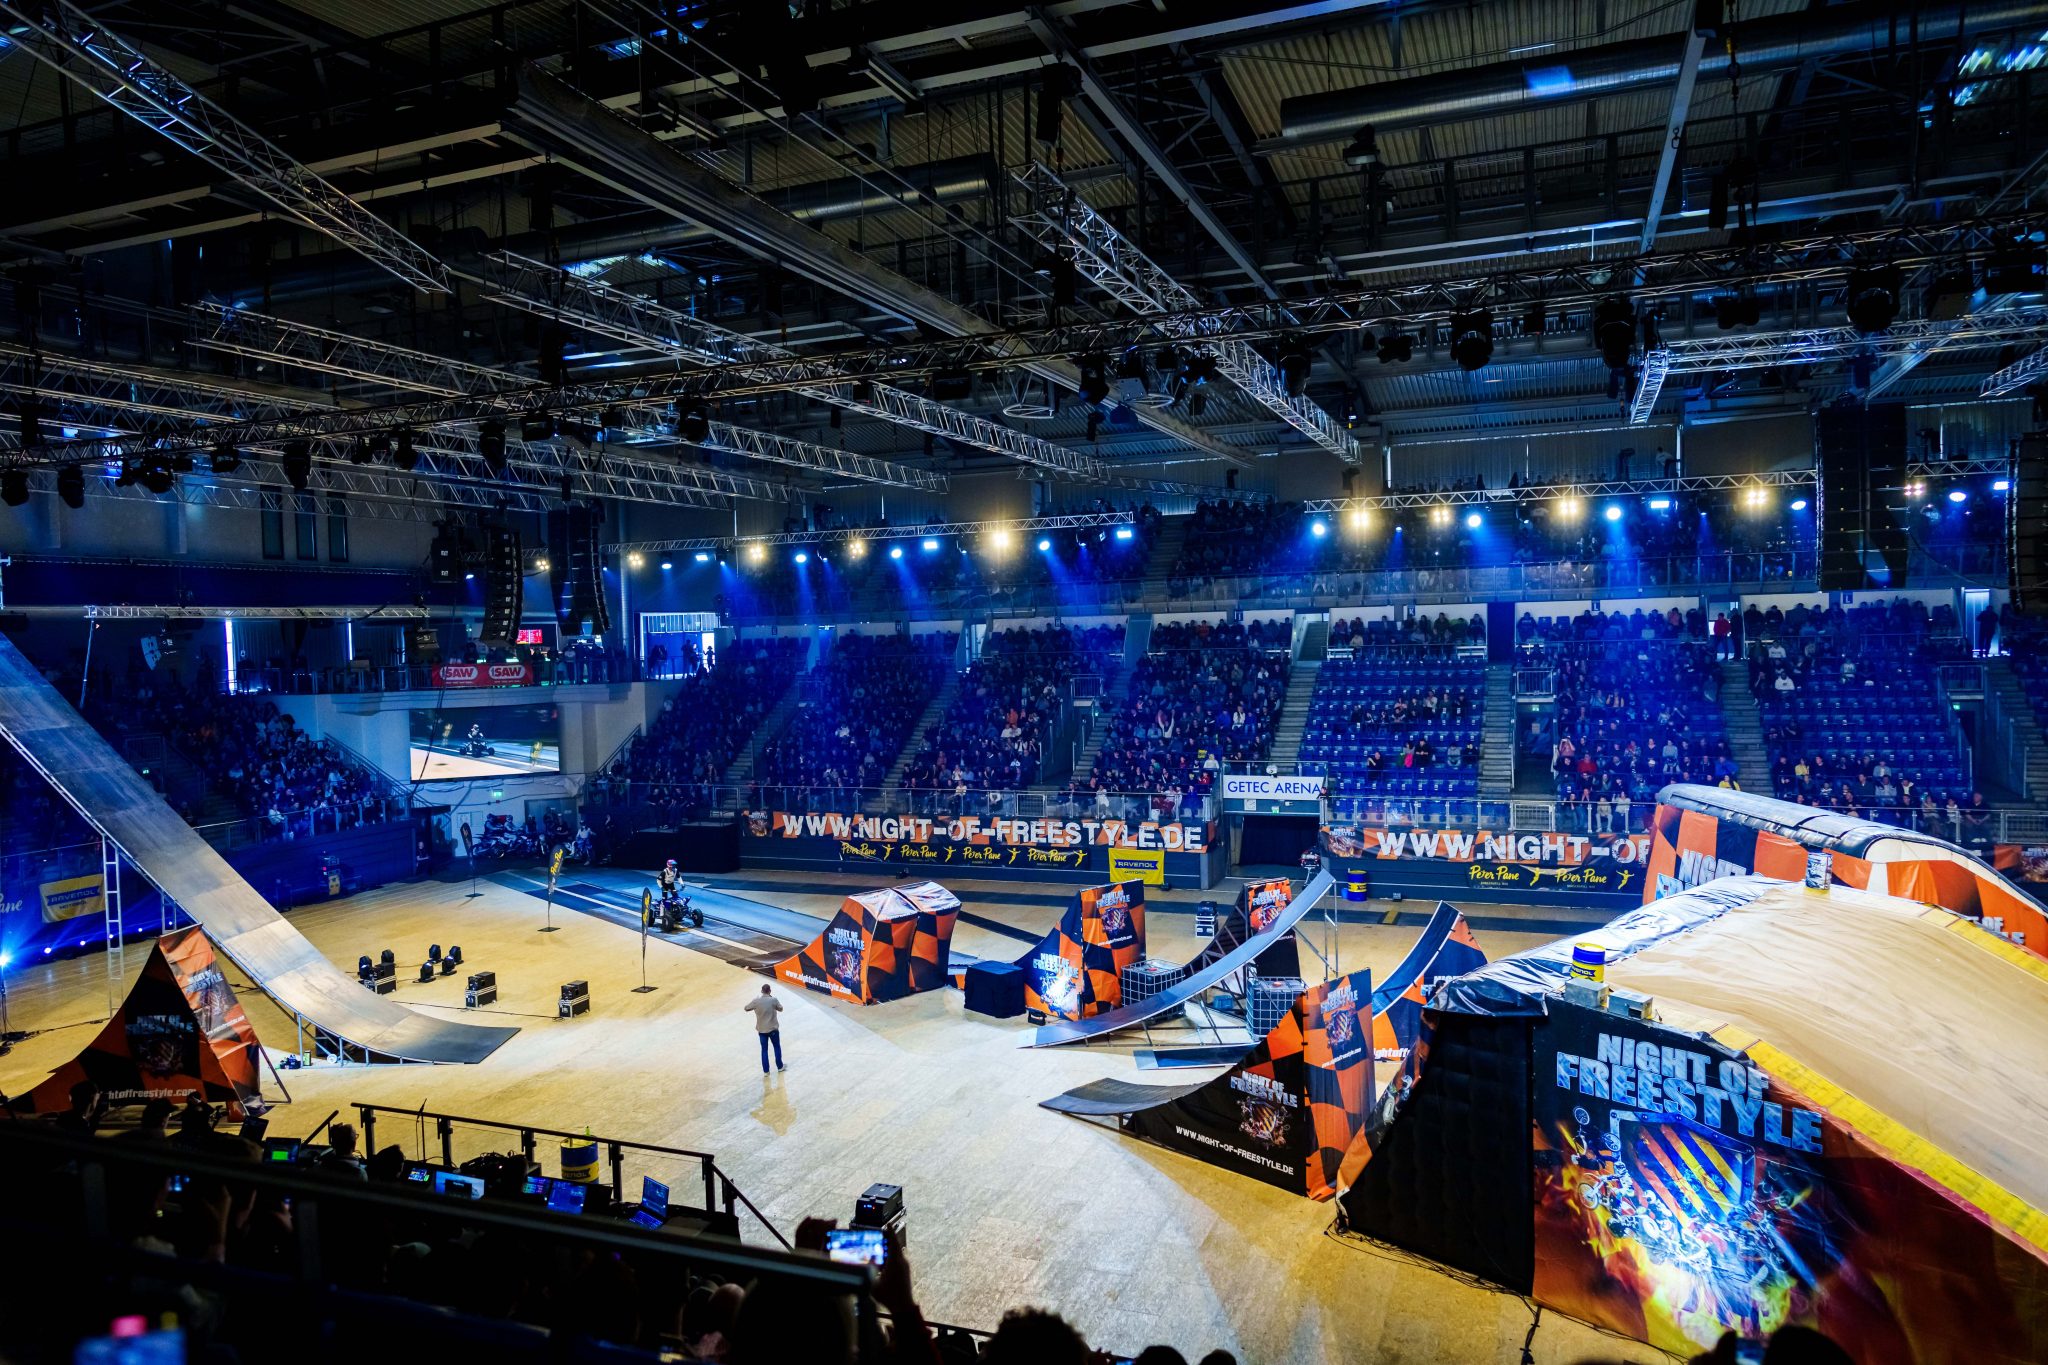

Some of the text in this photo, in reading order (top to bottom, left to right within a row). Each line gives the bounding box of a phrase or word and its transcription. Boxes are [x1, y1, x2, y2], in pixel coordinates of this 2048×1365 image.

[1227, 781, 1321, 794] GETEC ARENA
[782, 814, 1202, 850] WWW.NIGHT-OF-FREESTYLE.DE
[1496, 865, 1520, 881] Pane
[1582, 868, 1607, 883] Pane
[1597, 1032, 1769, 1100] NIGHT OF
[107, 1088, 197, 1100] htoffreestyle.com
[1230, 1076, 1298, 1108] FREESTYLE
[1241, 1070, 1285, 1093] NIGHT OF
[1556, 1051, 1823, 1155] FREESTYLE
[1175, 1125, 1294, 1176] WWW.NIGHT-OF-FREESTYLE.DE
